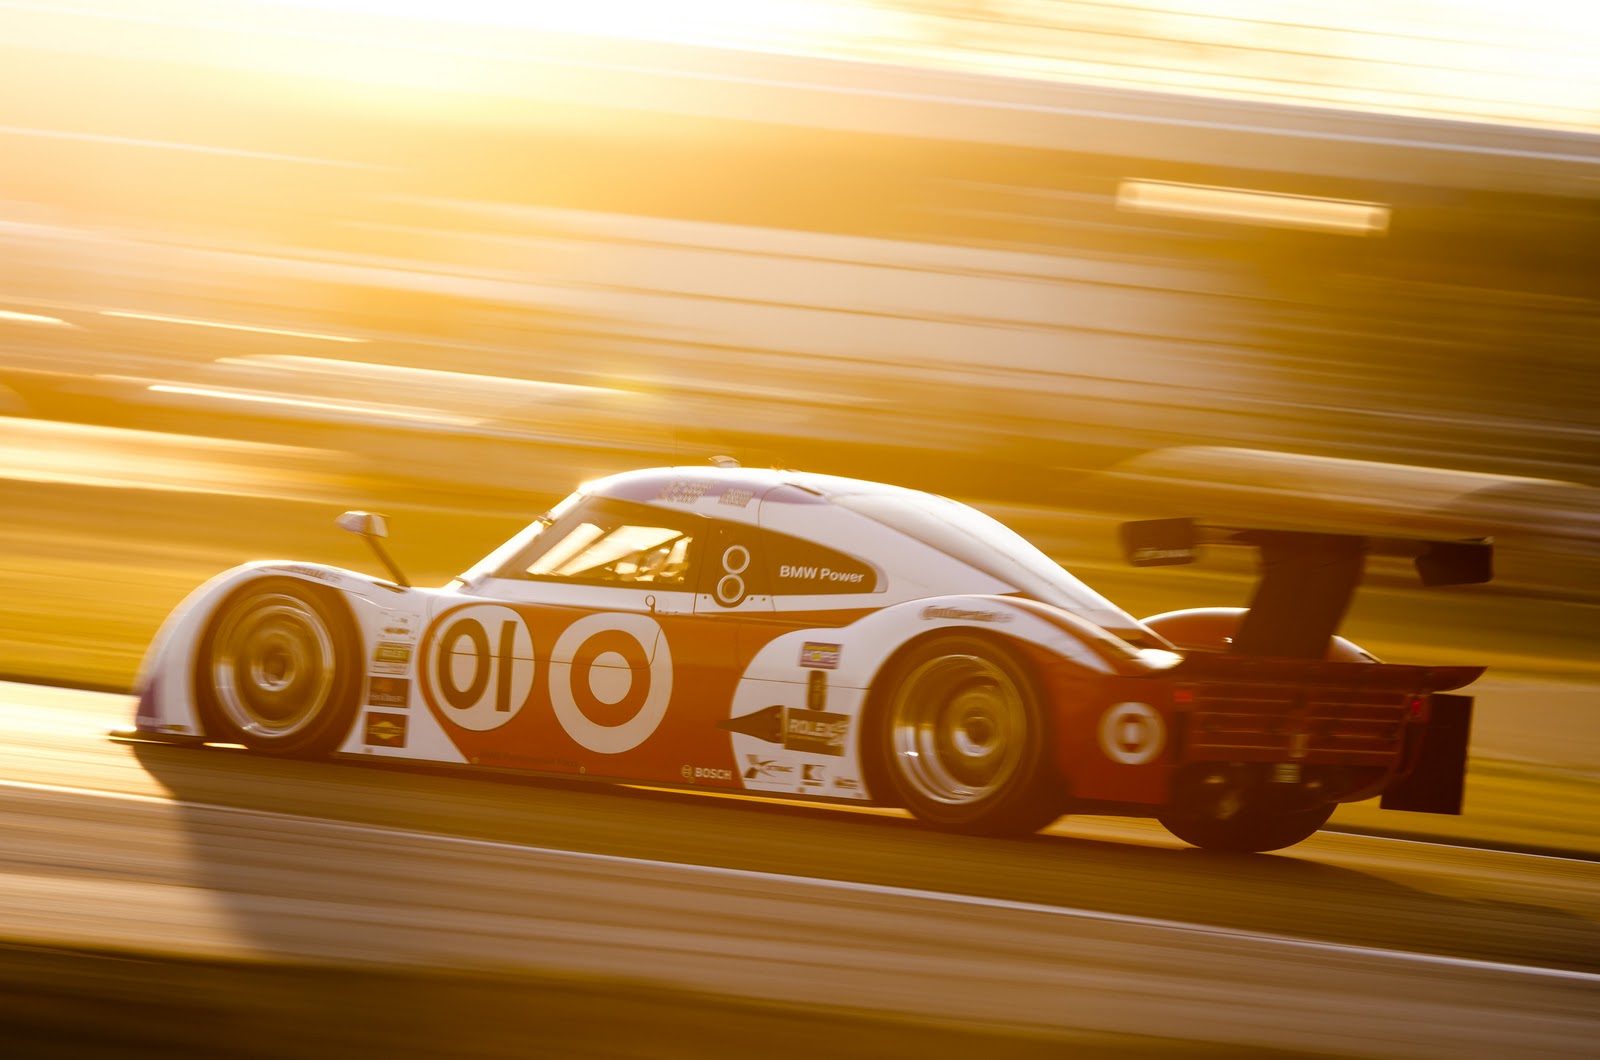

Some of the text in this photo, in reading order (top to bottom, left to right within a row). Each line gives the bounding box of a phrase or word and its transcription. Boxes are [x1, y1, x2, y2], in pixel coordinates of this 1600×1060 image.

[779, 565, 865, 583] BMW Power
[438, 617, 518, 713] 01
[694, 767, 732, 780] BOSCH
